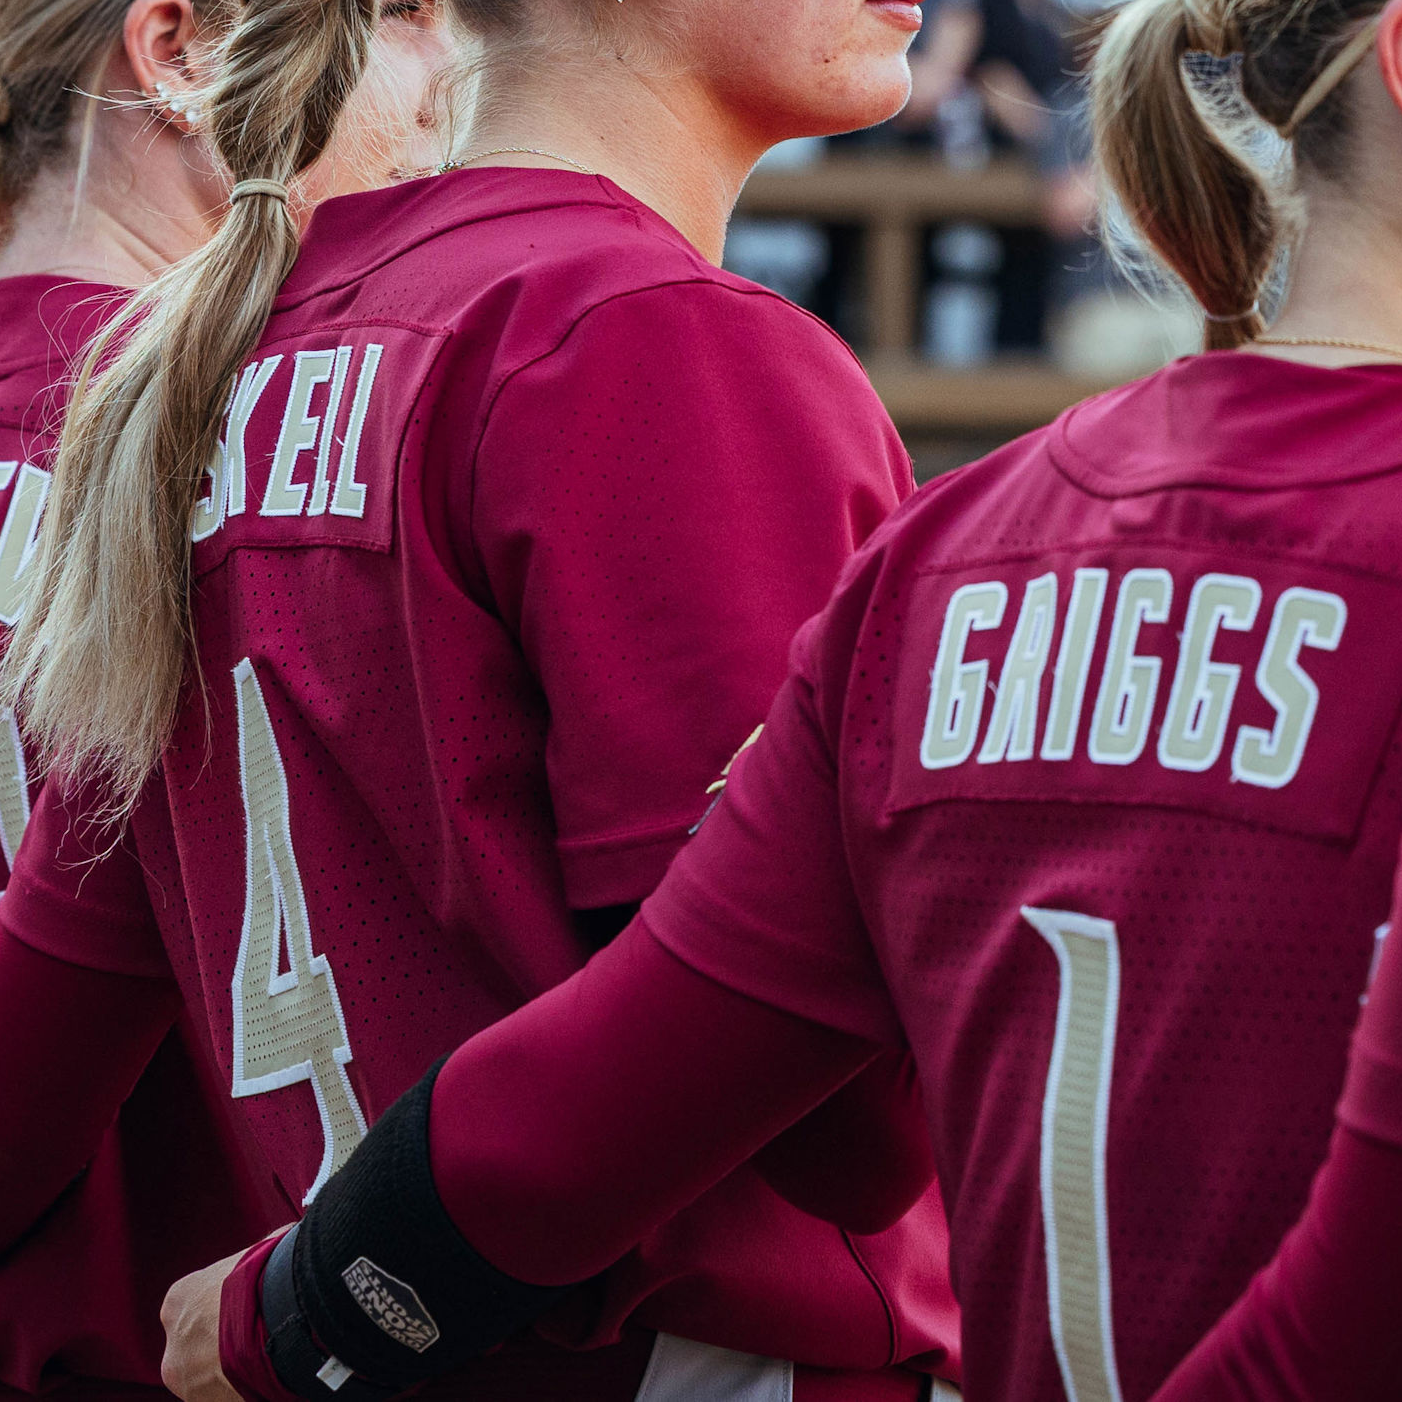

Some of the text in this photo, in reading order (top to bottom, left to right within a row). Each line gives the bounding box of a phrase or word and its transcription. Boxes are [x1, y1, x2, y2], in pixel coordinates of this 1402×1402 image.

[919, 567, 1348, 790] GRIGGS
[231, 657, 368, 1208] 4
[1021, 905, 1122, 1402] 1
[351, 1266, 430, 1344] ZONE
[360, 1261, 435, 1337] SPORTS
[377, 1318, 422, 1349] OWN
